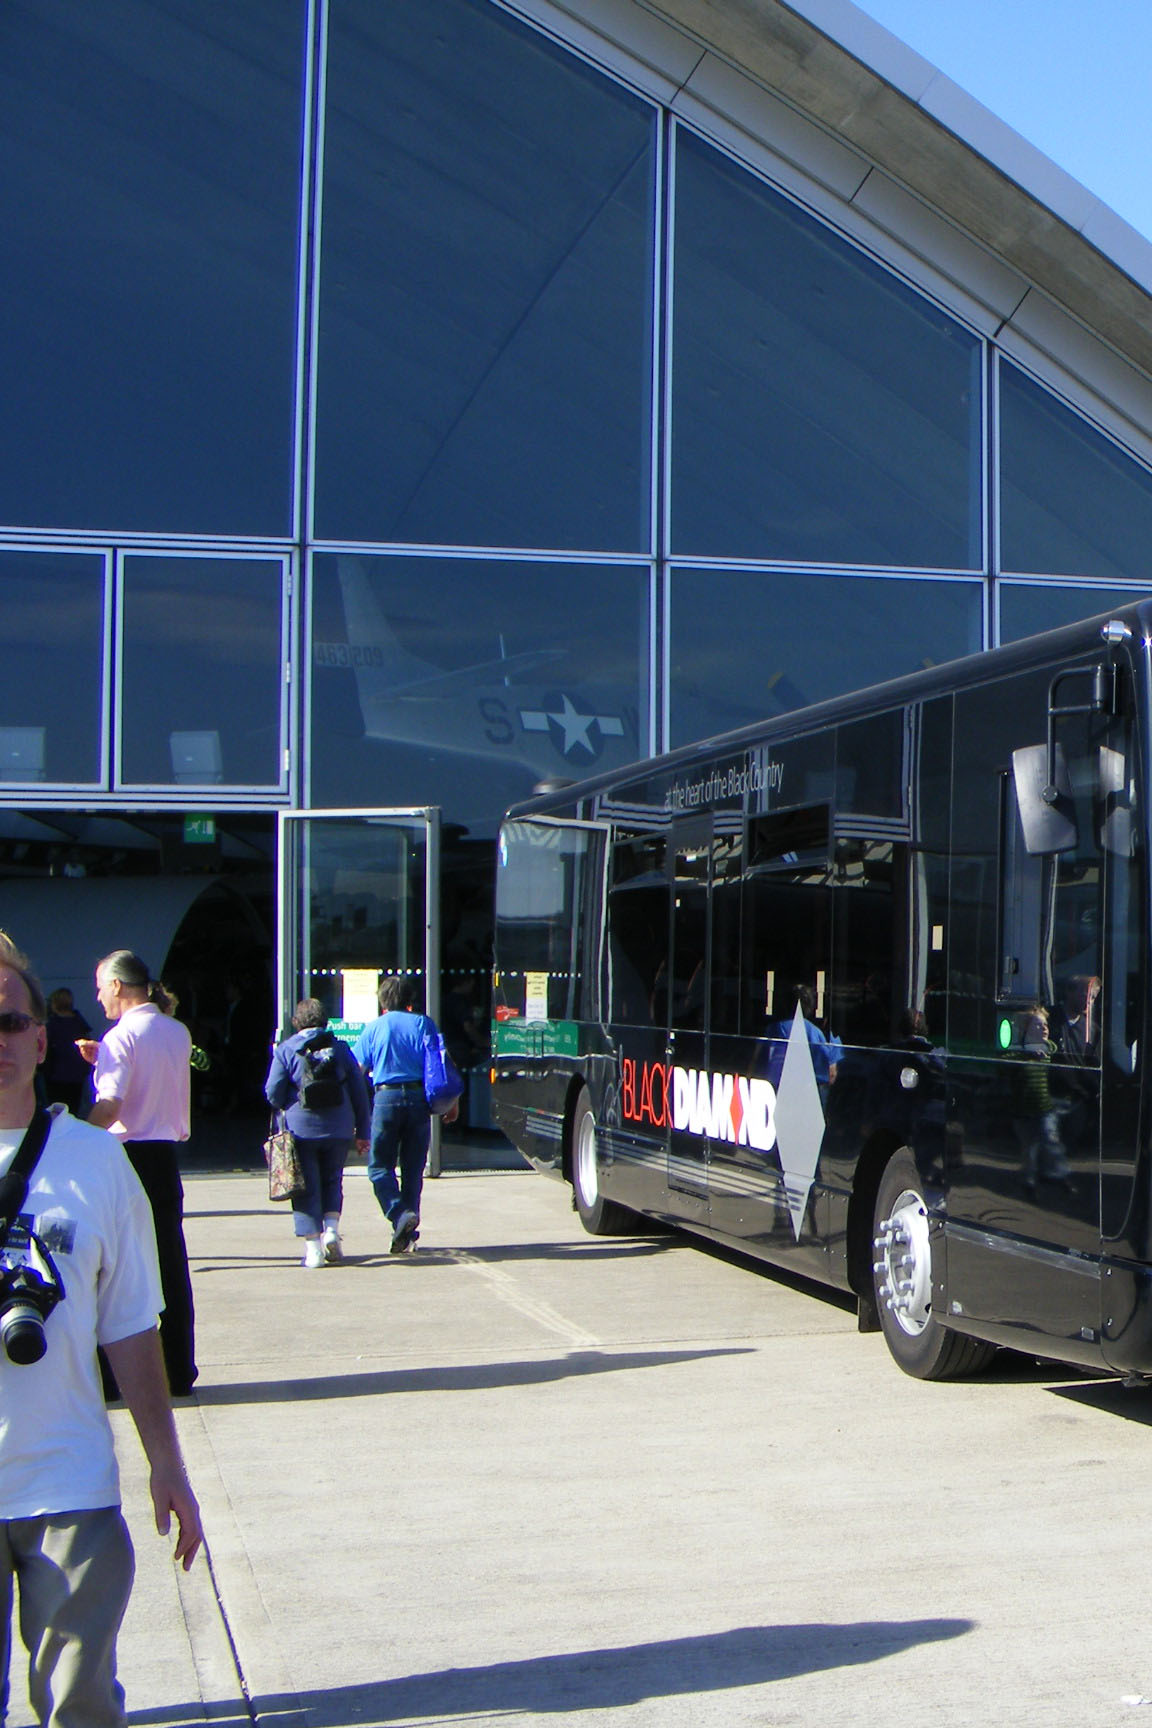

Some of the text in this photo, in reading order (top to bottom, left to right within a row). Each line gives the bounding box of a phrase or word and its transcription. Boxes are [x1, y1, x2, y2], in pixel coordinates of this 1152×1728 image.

[478, 696, 515, 744] S
[672, 780, 684, 809] the
[685, 776, 704, 807] heart
[705, 770, 714, 802] of
[714, 768, 727, 800] the
[728, 763, 749, 797] Black
[750, 760, 784, 793] Country
[623, 1058, 674, 1129] BLACK
